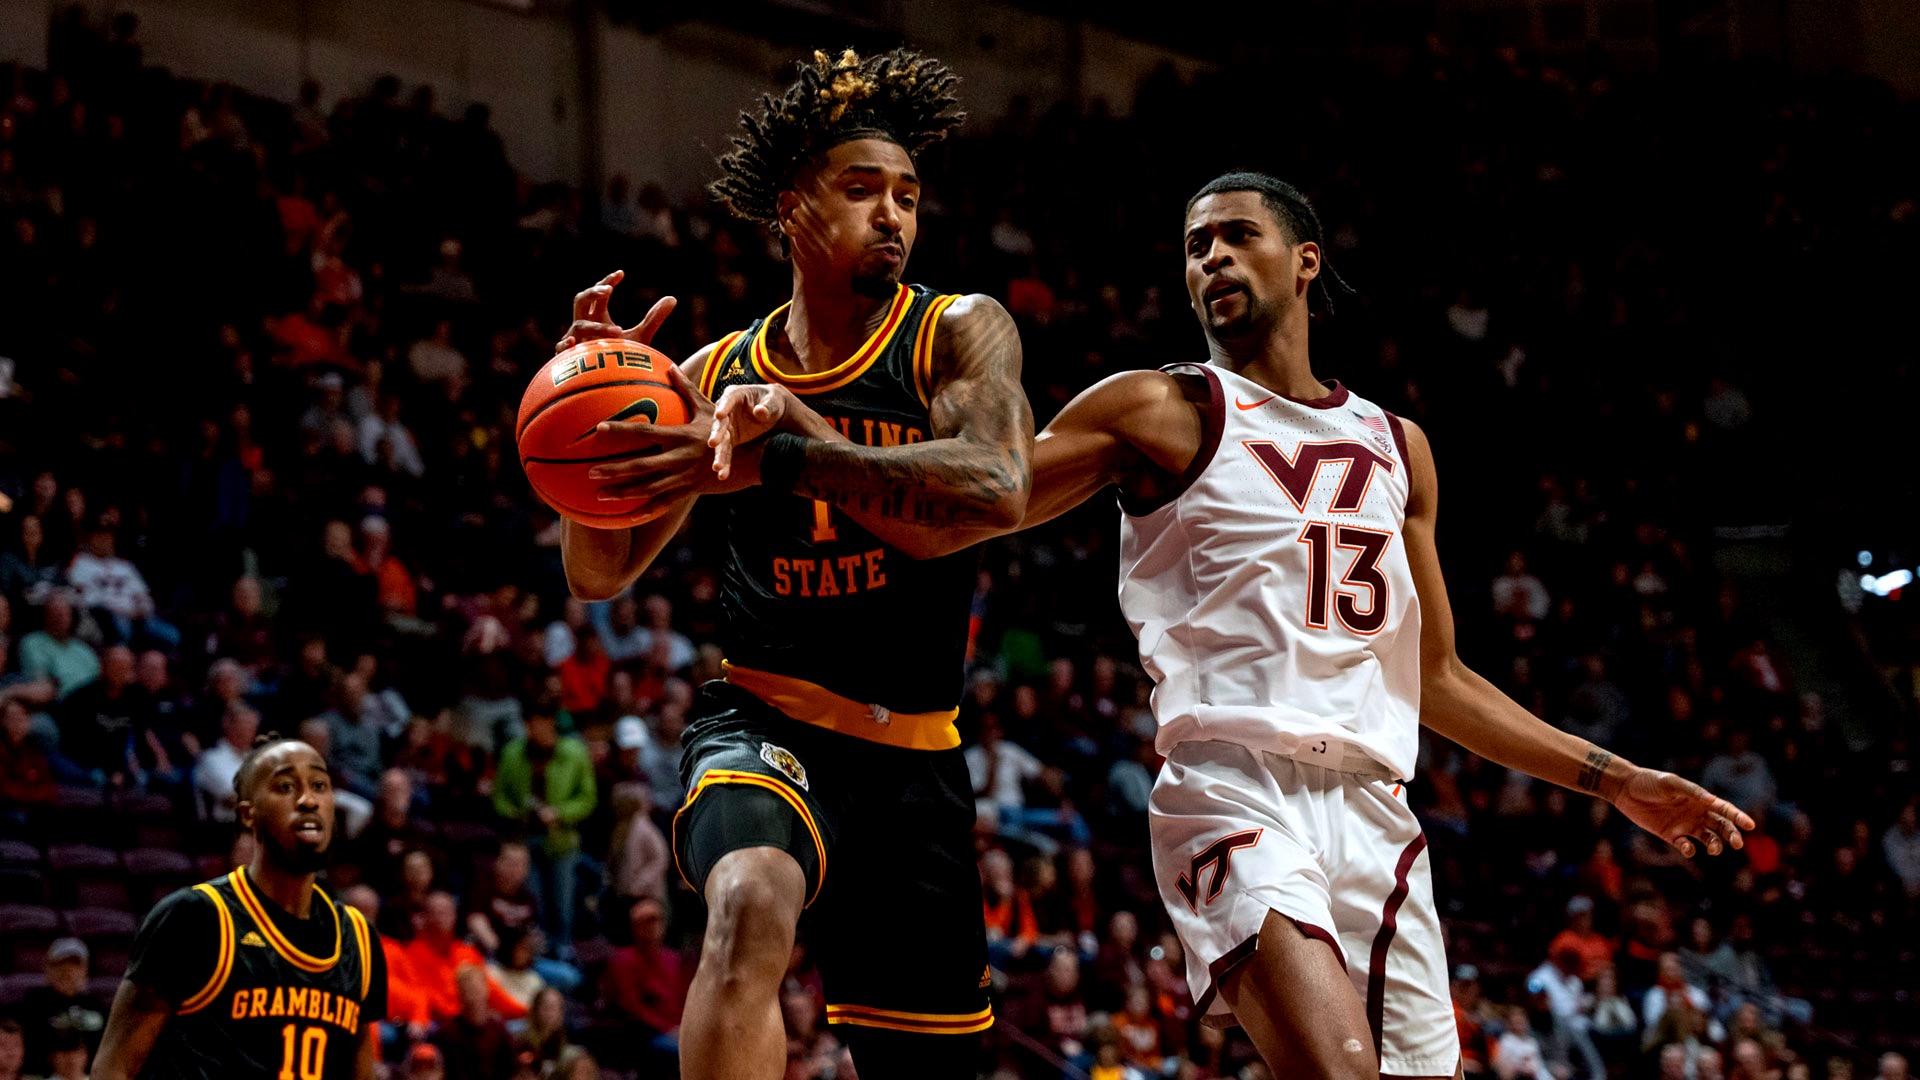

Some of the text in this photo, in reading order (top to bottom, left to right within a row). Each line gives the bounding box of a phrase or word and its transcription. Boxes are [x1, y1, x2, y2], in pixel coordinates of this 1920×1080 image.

[551, 351, 653, 387] ELITE
[1241, 440, 1396, 513] VT
[773, 548, 886, 598] STATE
[1297, 520, 1393, 635] 13
[1174, 827, 1263, 916] VT
[231, 986, 360, 1034] GRAMBLING
[279, 1023, 328, 1080] 10
